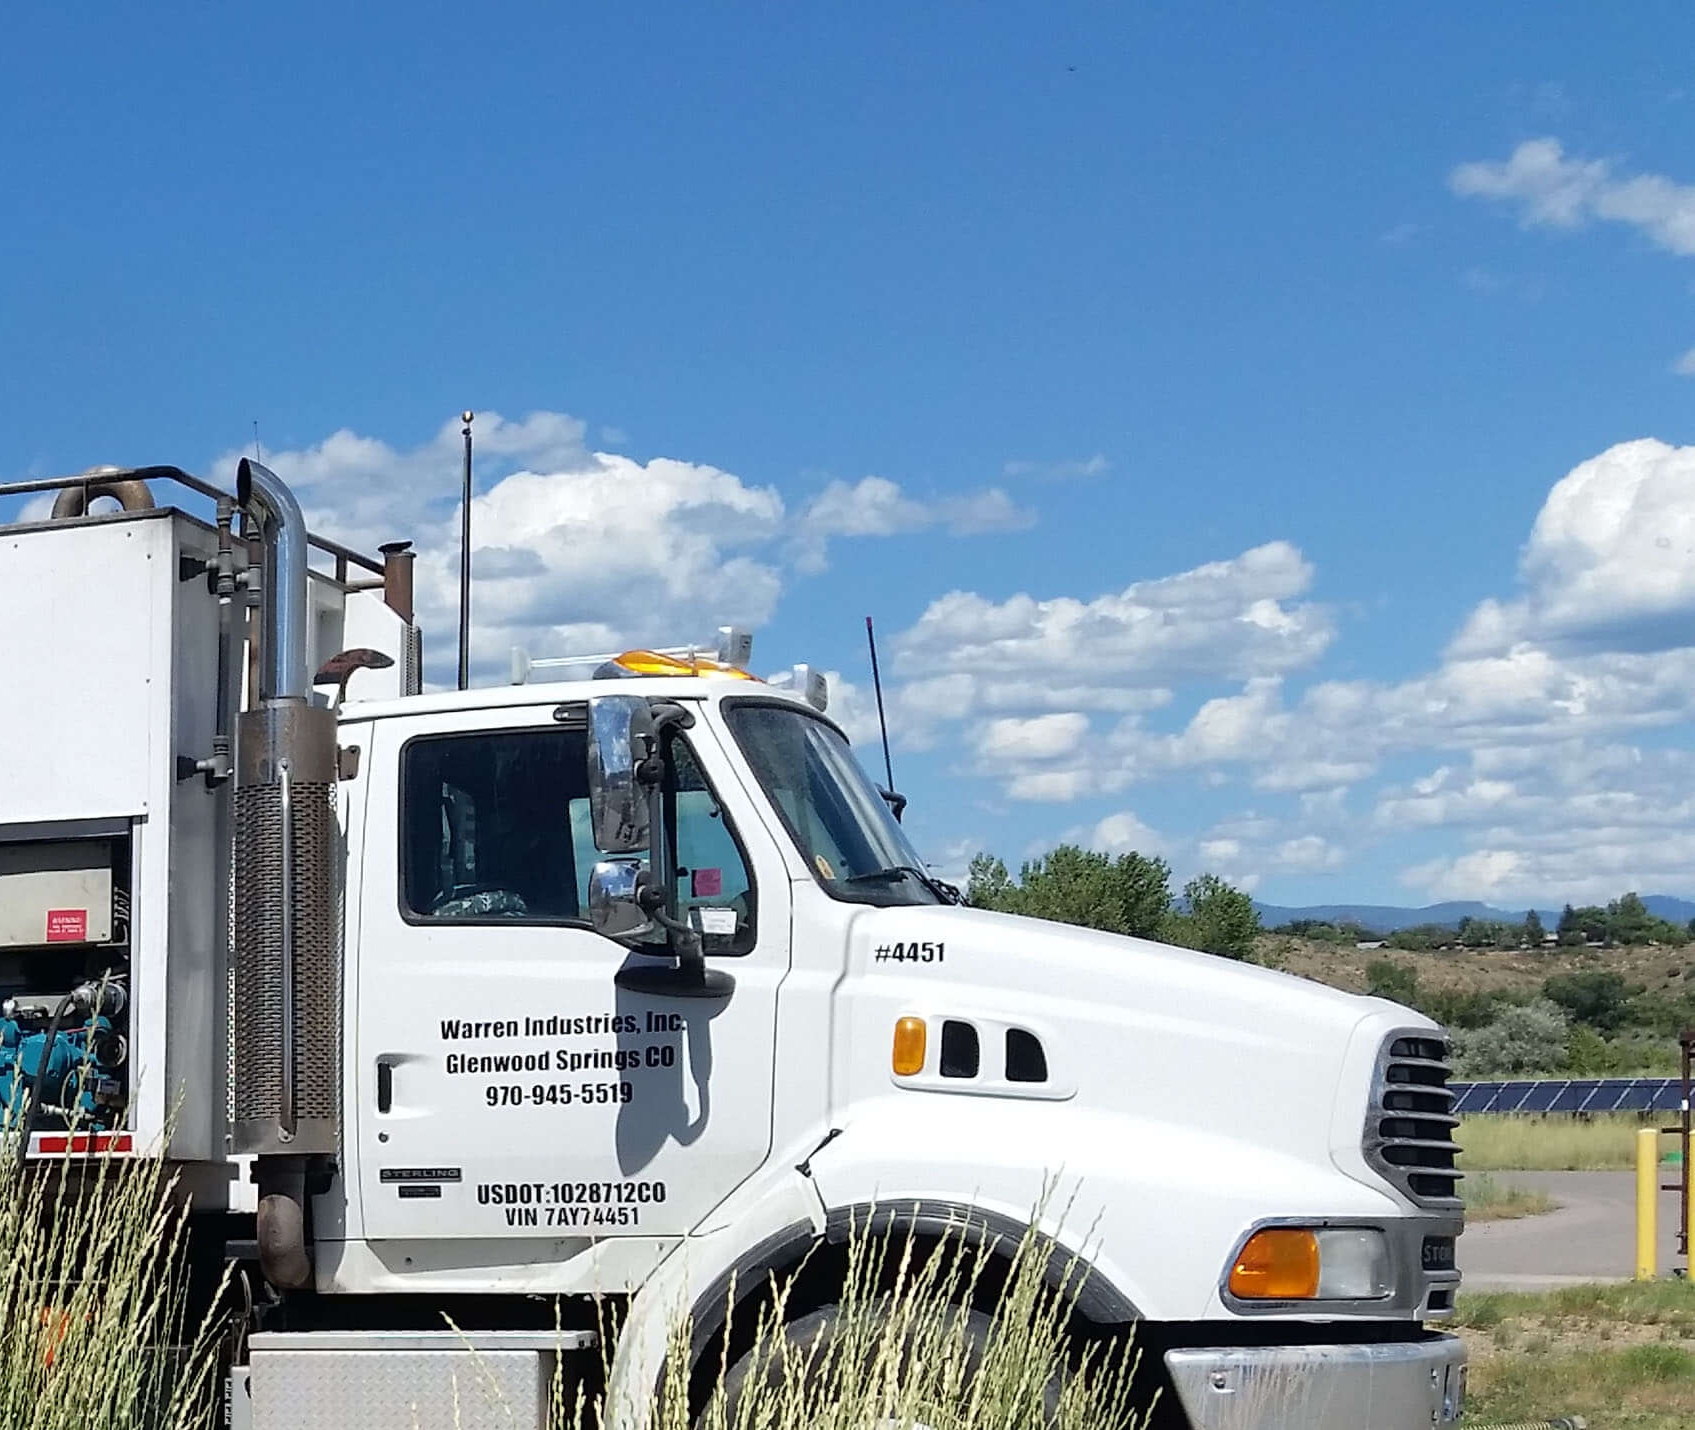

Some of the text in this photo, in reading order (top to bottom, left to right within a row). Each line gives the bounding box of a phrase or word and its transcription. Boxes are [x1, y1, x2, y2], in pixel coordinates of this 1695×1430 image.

[873, 941, 945, 962] #4451
[441, 1011, 687, 1040] Warren Industries, Inc.
[446, 1045, 675, 1074] Glenwood Springs CO
[486, 1081, 634, 1106] 970-945-5519
[381, 1169, 459, 1178] STERLING
[477, 1182, 667, 1204] USDOT:1028712CO
[505, 1207, 640, 1226] VIN 7AY74451
